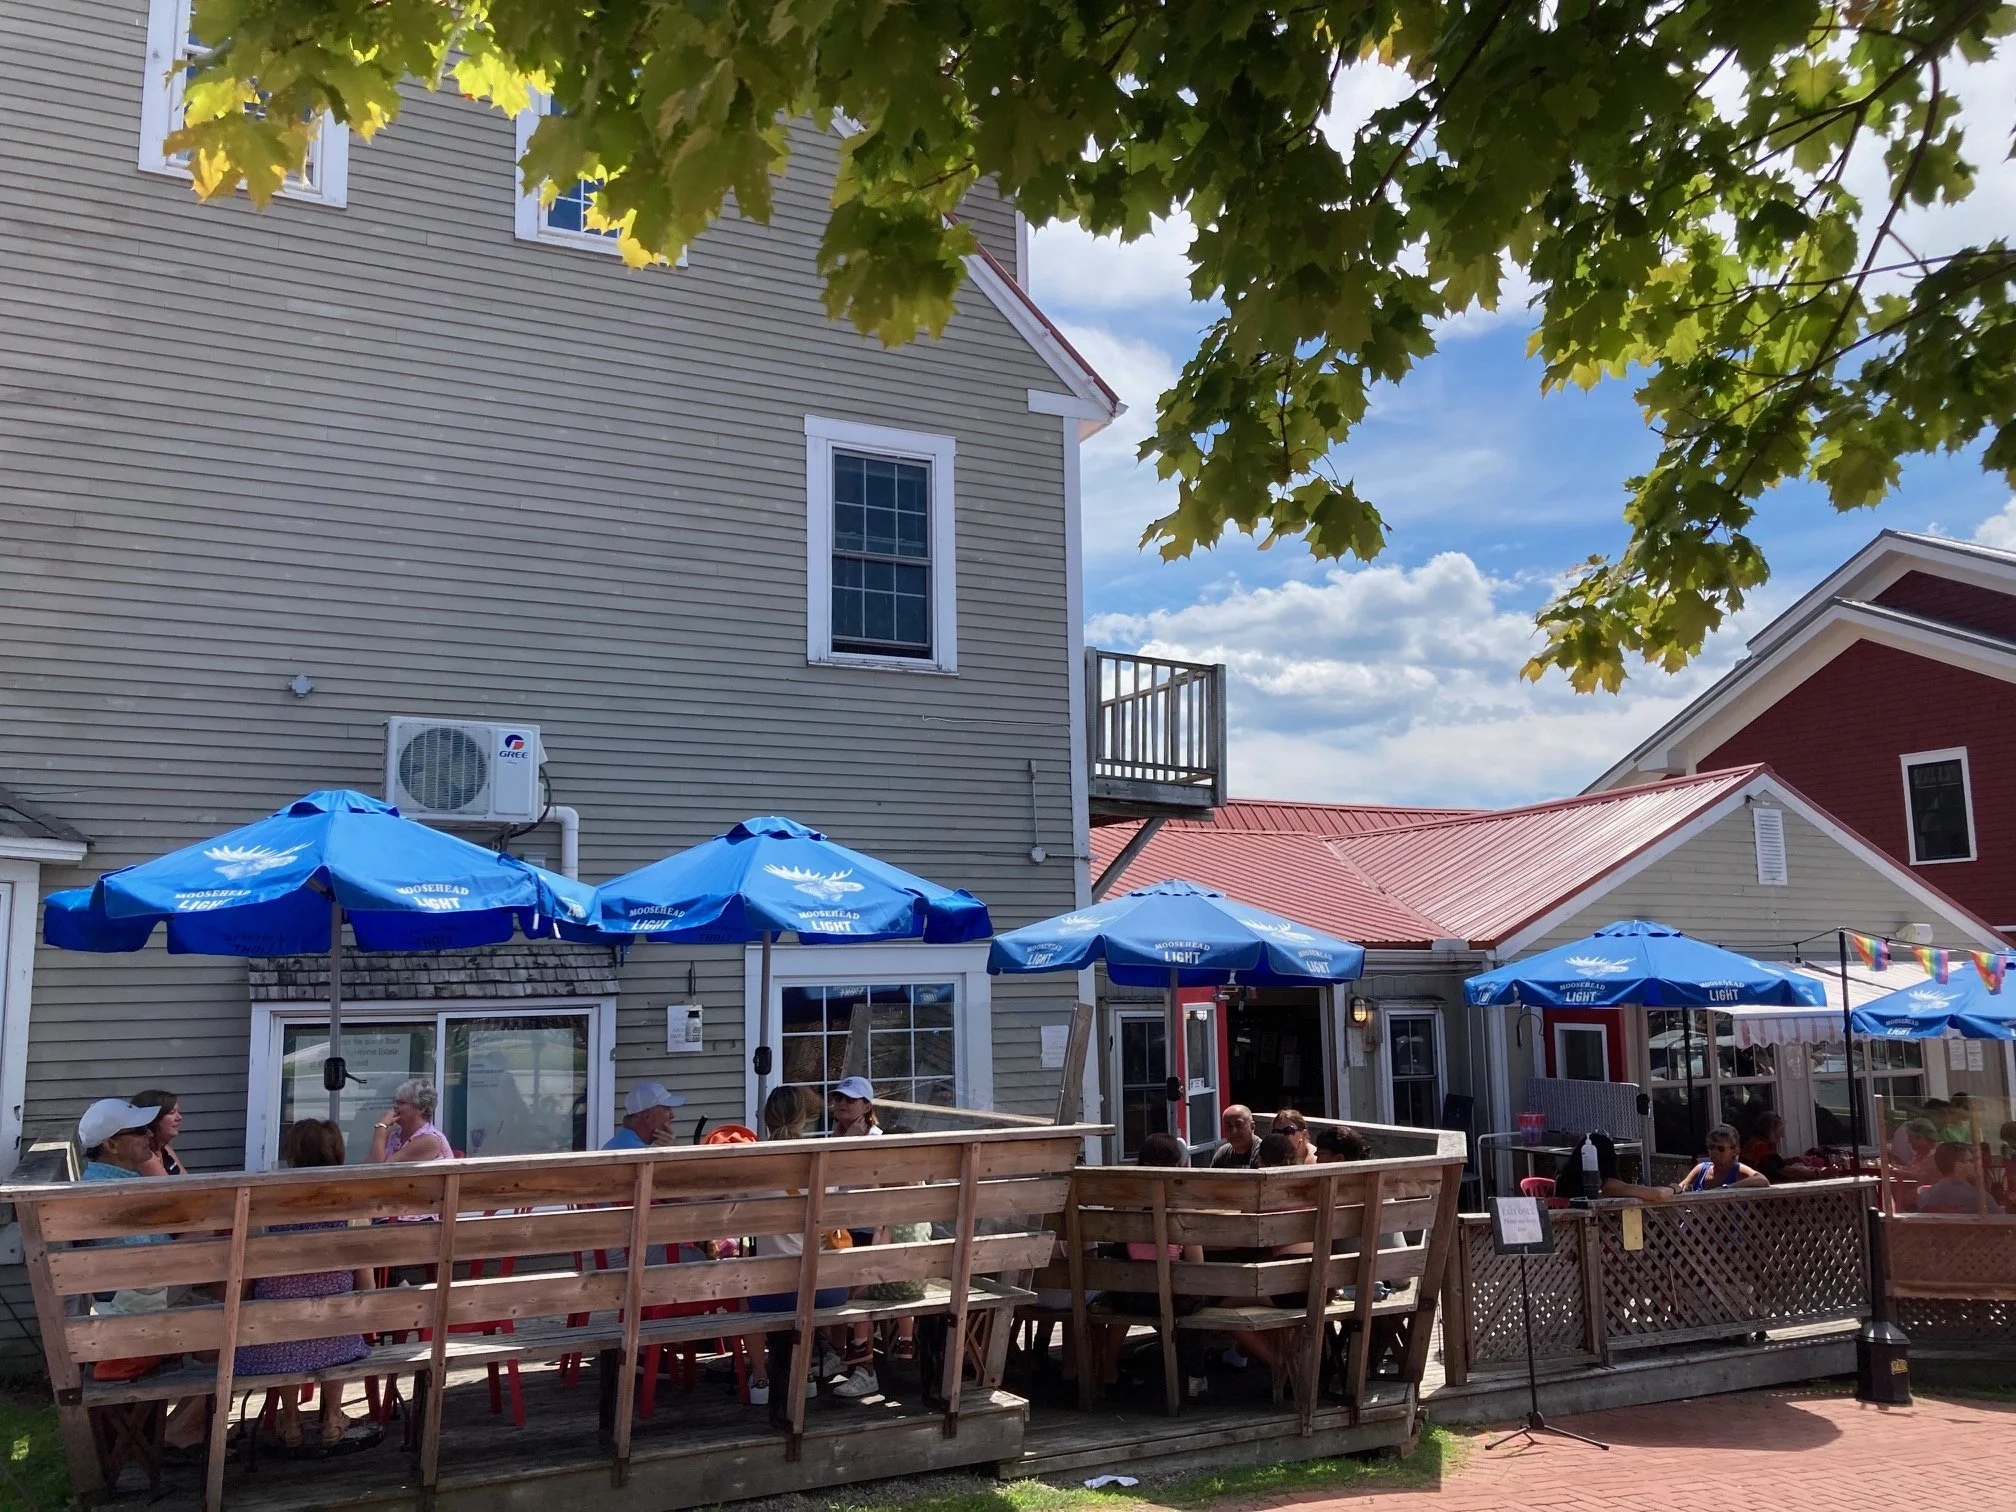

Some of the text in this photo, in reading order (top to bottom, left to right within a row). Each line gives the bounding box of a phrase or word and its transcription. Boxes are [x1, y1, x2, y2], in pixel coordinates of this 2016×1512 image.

[499, 750, 528, 759] GREE
[175, 889, 252, 899] MOOSEHEAD
[412, 896, 461, 910] LIGHT
[629, 905, 686, 918] MOOSEHEAD
[798, 910, 860, 920] MOOSEHEAD
[631, 919, 673, 931] LIGHT
[811, 920, 851, 932] LIGHT
[1027, 943, 1063, 952] MOOSEHEAD
[1154, 941, 1210, 951] MOOSEHEAD
[1027, 953, 1053, 965] LIGHT
[1164, 951, 1200, 964] LIGHT
[1306, 960, 1330, 974] LIGHT
[1559, 981, 1606, 991] MOOSEHEAD
[1699, 980, 1745, 988] MOOSEHEAD
[1565, 991, 1597, 1002] LIGHT
[1709, 989, 1739, 1002] LIGHT
[1885, 1018, 1919, 1027] MOOSEHEAD
[1886, 1027, 1913, 1036] LIGHT
